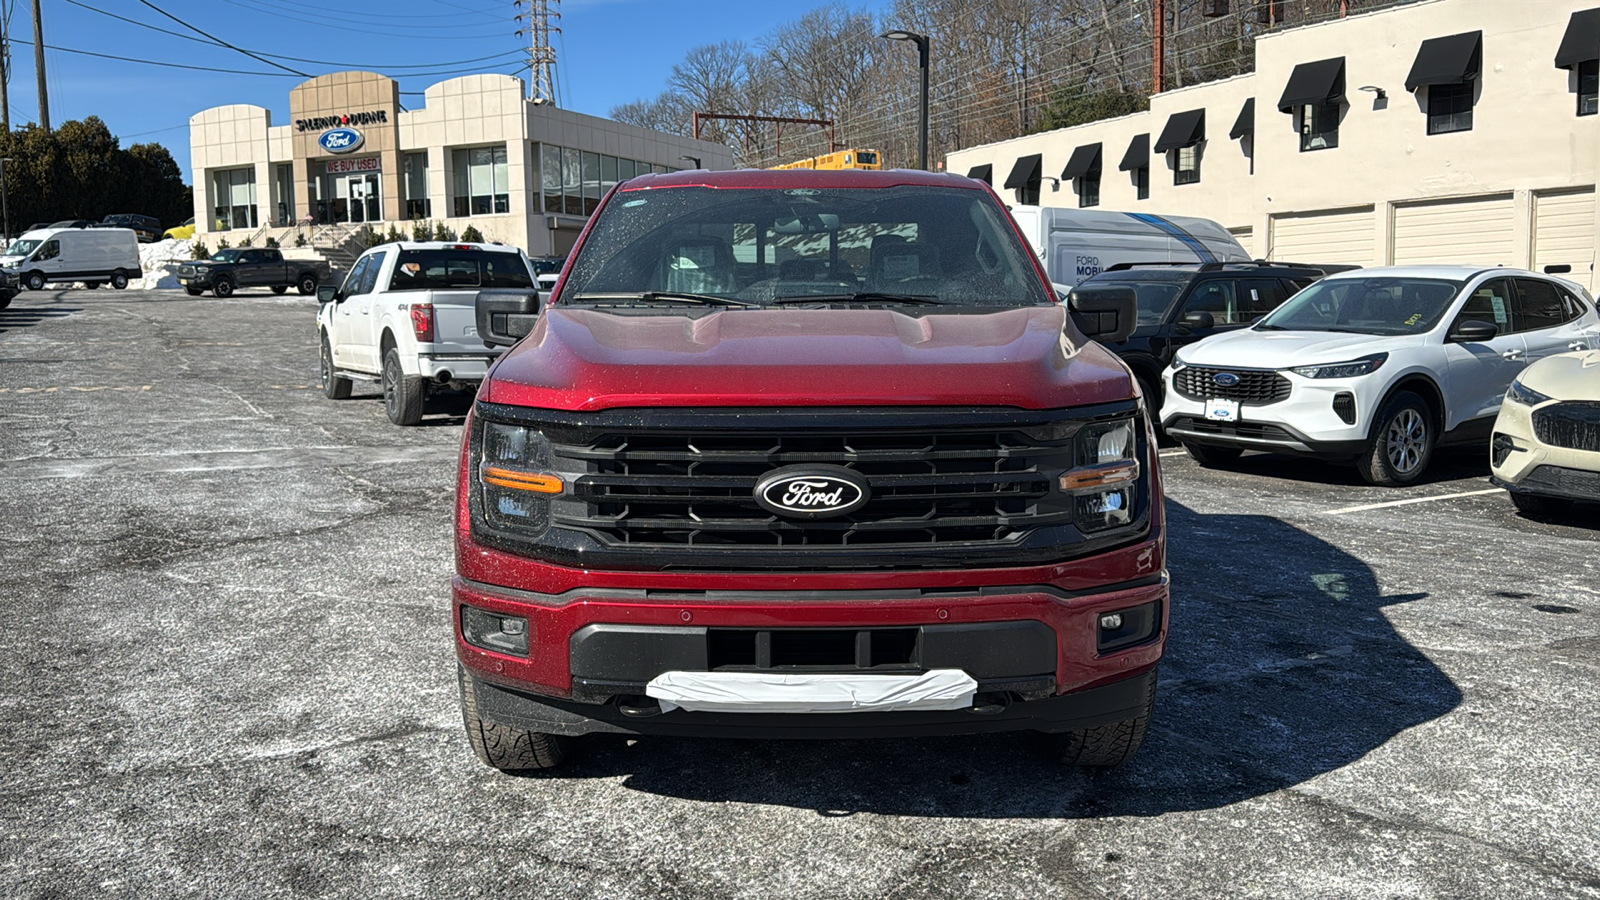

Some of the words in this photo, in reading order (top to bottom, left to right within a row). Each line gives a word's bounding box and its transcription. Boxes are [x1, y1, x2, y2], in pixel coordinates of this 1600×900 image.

[326, 132, 350, 148] Ford
[327, 161, 339, 172] WE
[340, 160, 355, 171] BUY
[357, 158, 378, 169] USED
[1076, 256, 1099, 266] FORD
[782, 481, 843, 506] Ford
